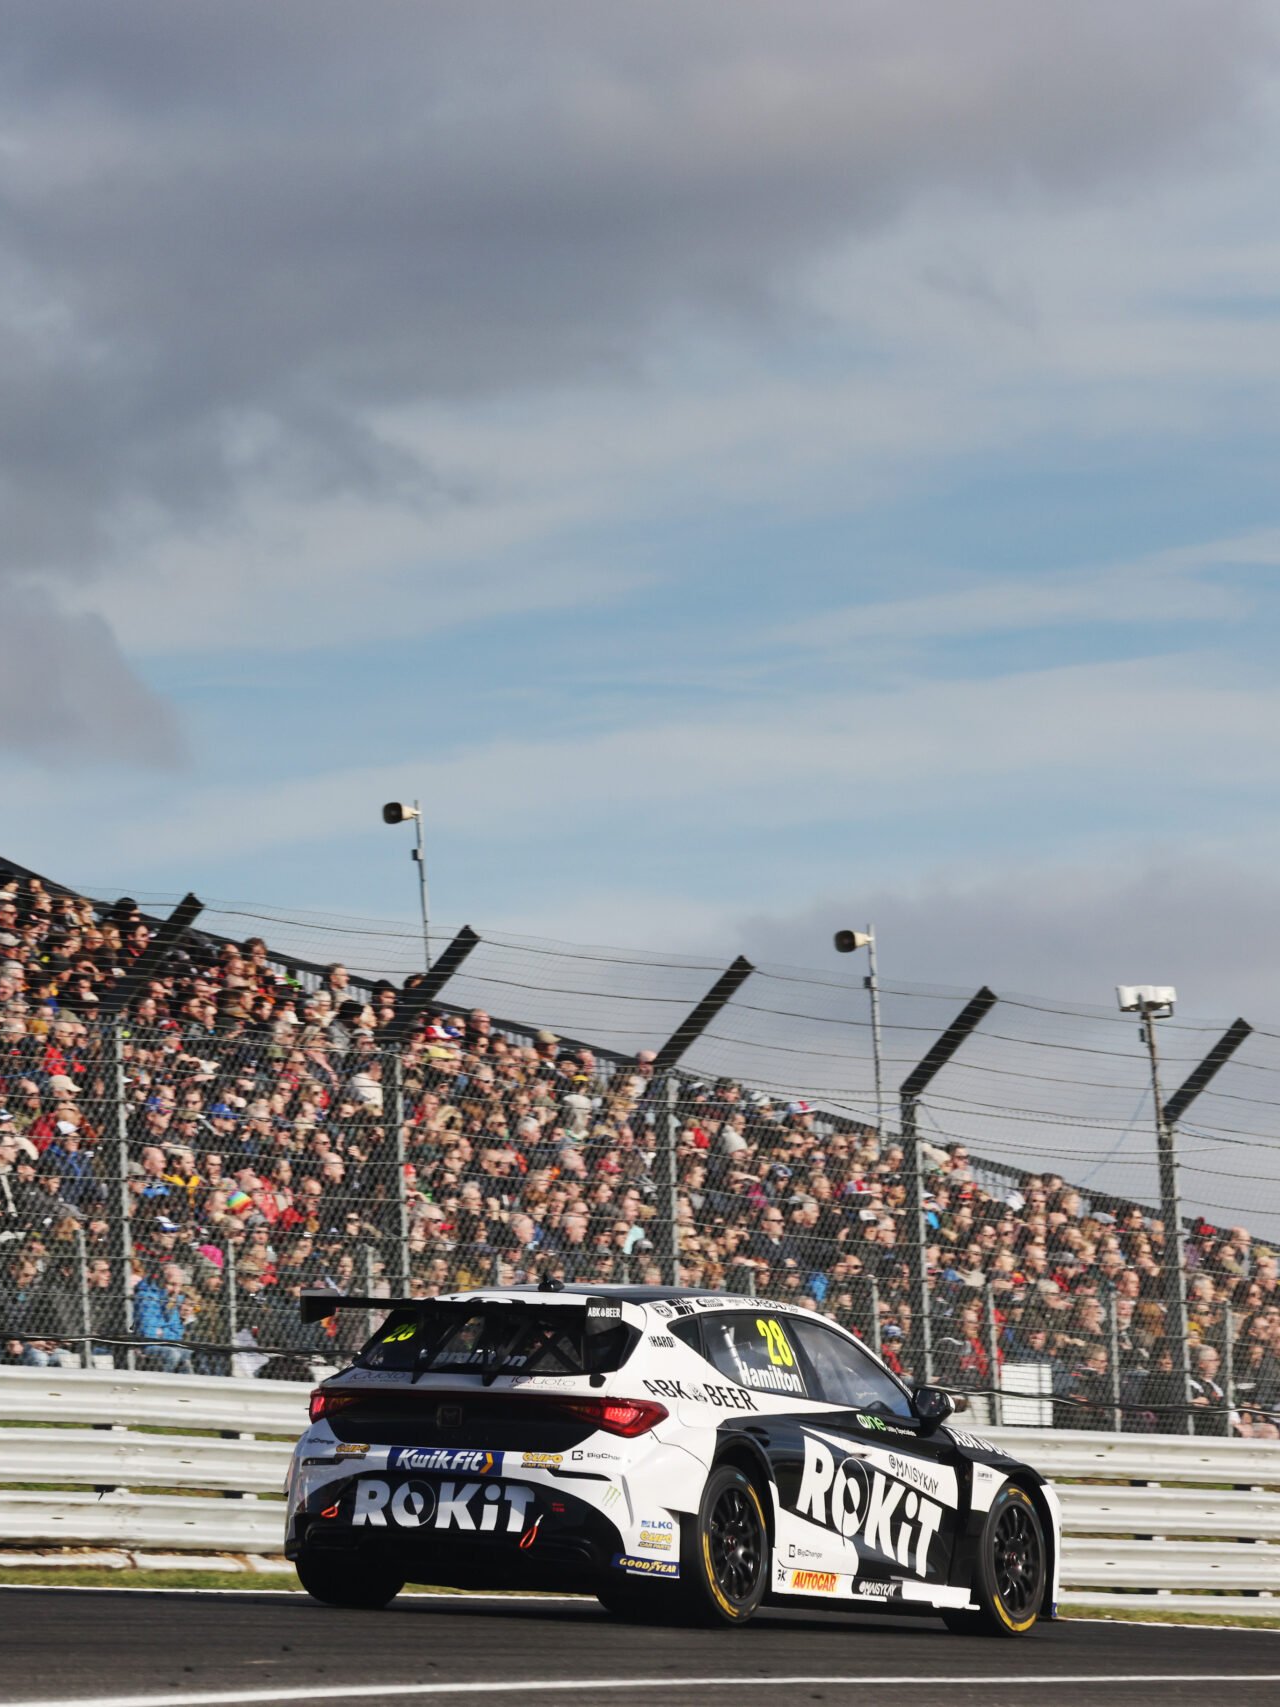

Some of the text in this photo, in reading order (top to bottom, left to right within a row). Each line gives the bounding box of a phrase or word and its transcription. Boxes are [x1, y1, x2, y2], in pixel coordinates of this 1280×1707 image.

[587, 1307, 621, 1318] ABK BEER
[756, 1319, 794, 1367] 28
[739, 1361, 803, 1393] Hamilton
[642, 1379, 759, 1411] ABK BEER
[888, 1454, 939, 1495] @MAISYKAY
[797, 1548, 822, 1559] BigChange
[793, 1571, 837, 1593] AUTOCAR
